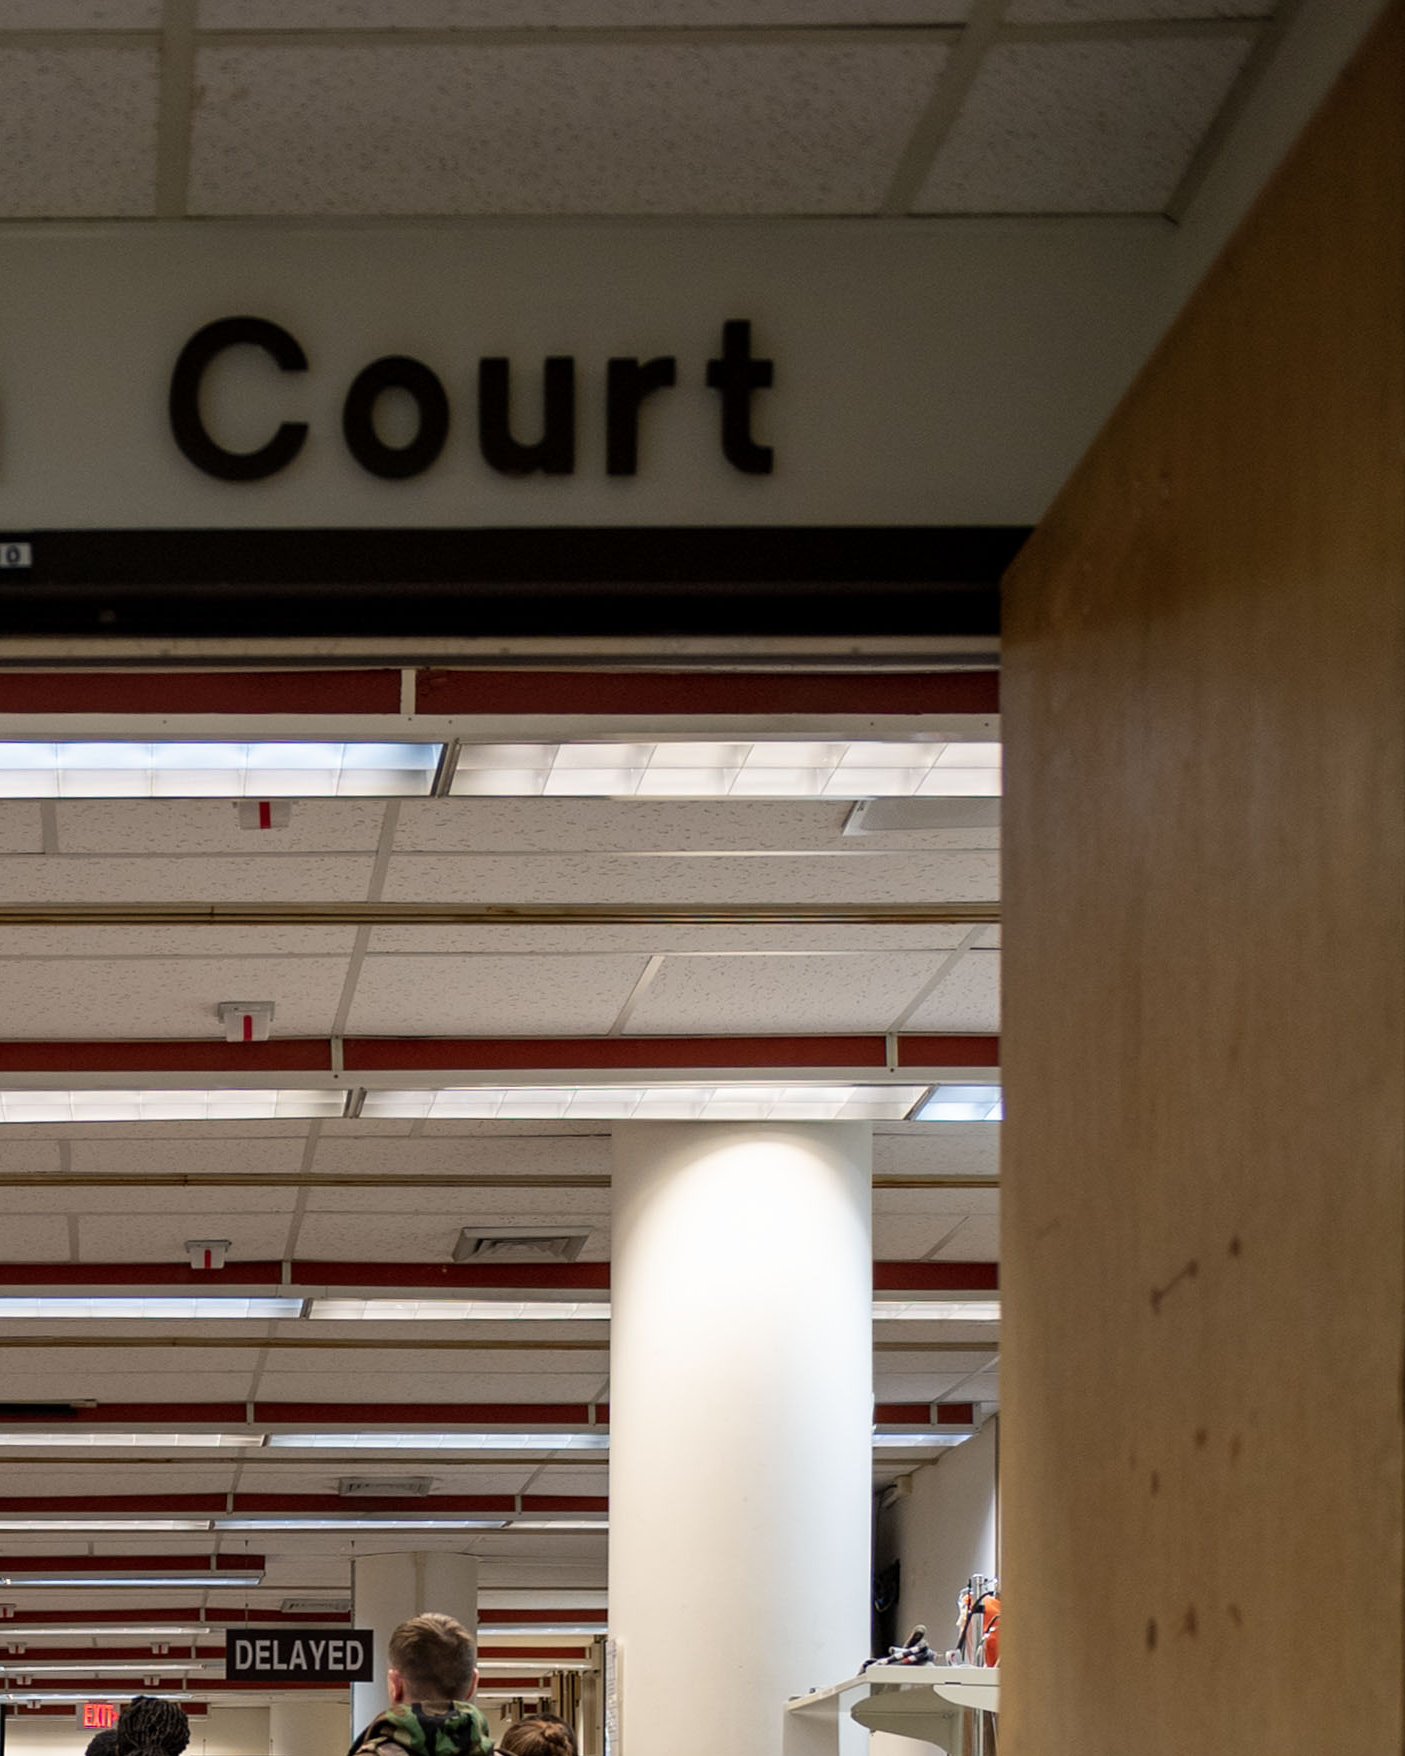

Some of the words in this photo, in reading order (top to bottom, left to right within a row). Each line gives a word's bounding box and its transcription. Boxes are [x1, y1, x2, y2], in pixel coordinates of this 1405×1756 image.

[169, 315, 774, 481] Court
[235, 1640, 364, 1671] DELAYED
[83, 1703, 113, 1728] EXIT
